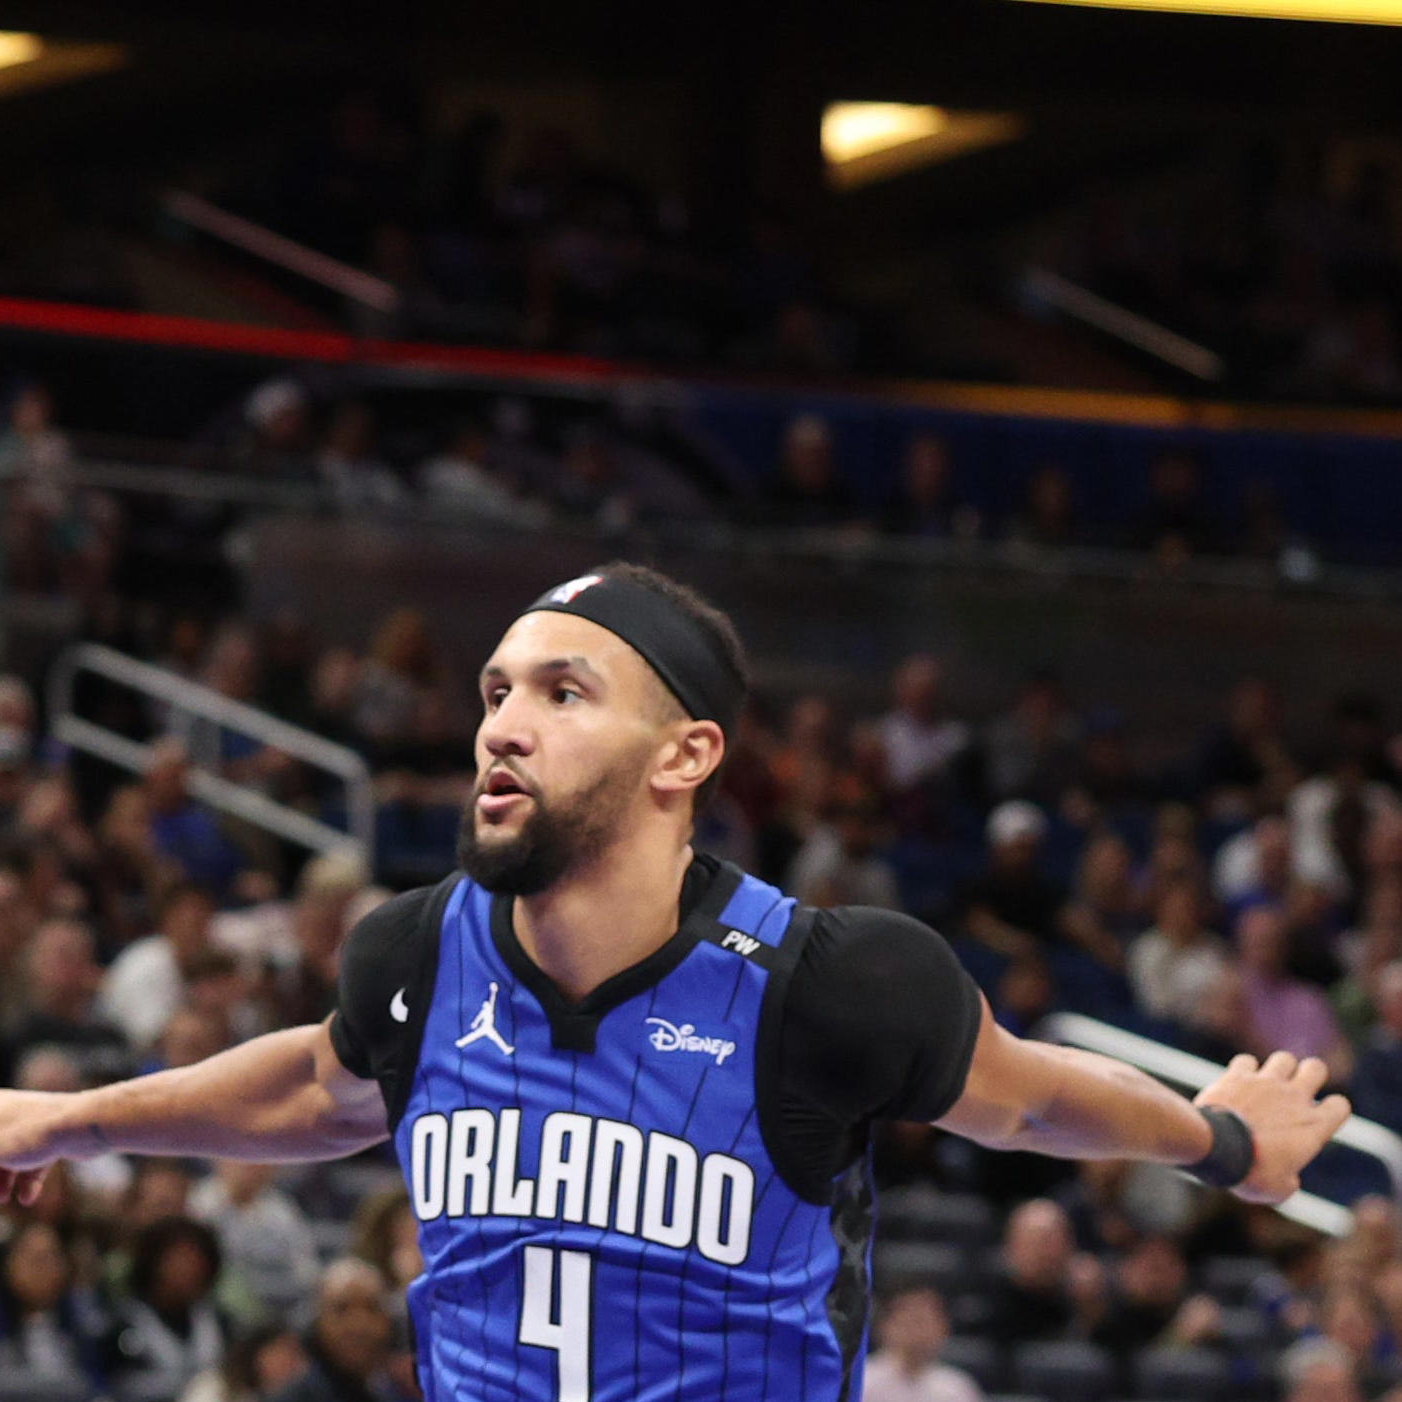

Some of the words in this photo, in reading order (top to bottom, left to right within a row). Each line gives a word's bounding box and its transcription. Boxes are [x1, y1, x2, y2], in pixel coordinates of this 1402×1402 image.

[721, 930, 762, 956] PW
[645, 1017, 736, 1065] Disney
[410, 1107, 756, 1267] ORLANDO
